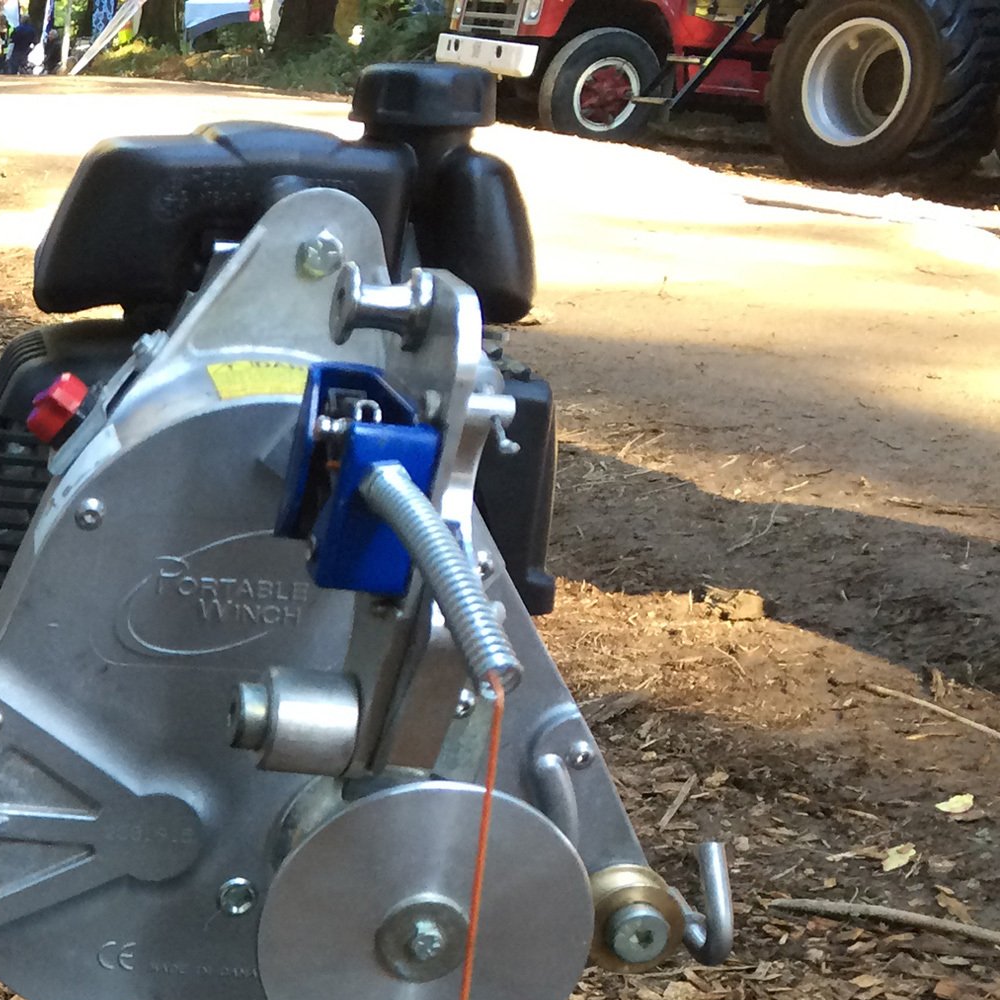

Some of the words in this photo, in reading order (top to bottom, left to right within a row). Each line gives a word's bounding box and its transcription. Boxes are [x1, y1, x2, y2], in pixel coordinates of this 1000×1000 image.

[155, 555, 310, 602] PORTABLE
[198, 598, 302, 625] WINCH
[98, 941, 137, 970] CE
